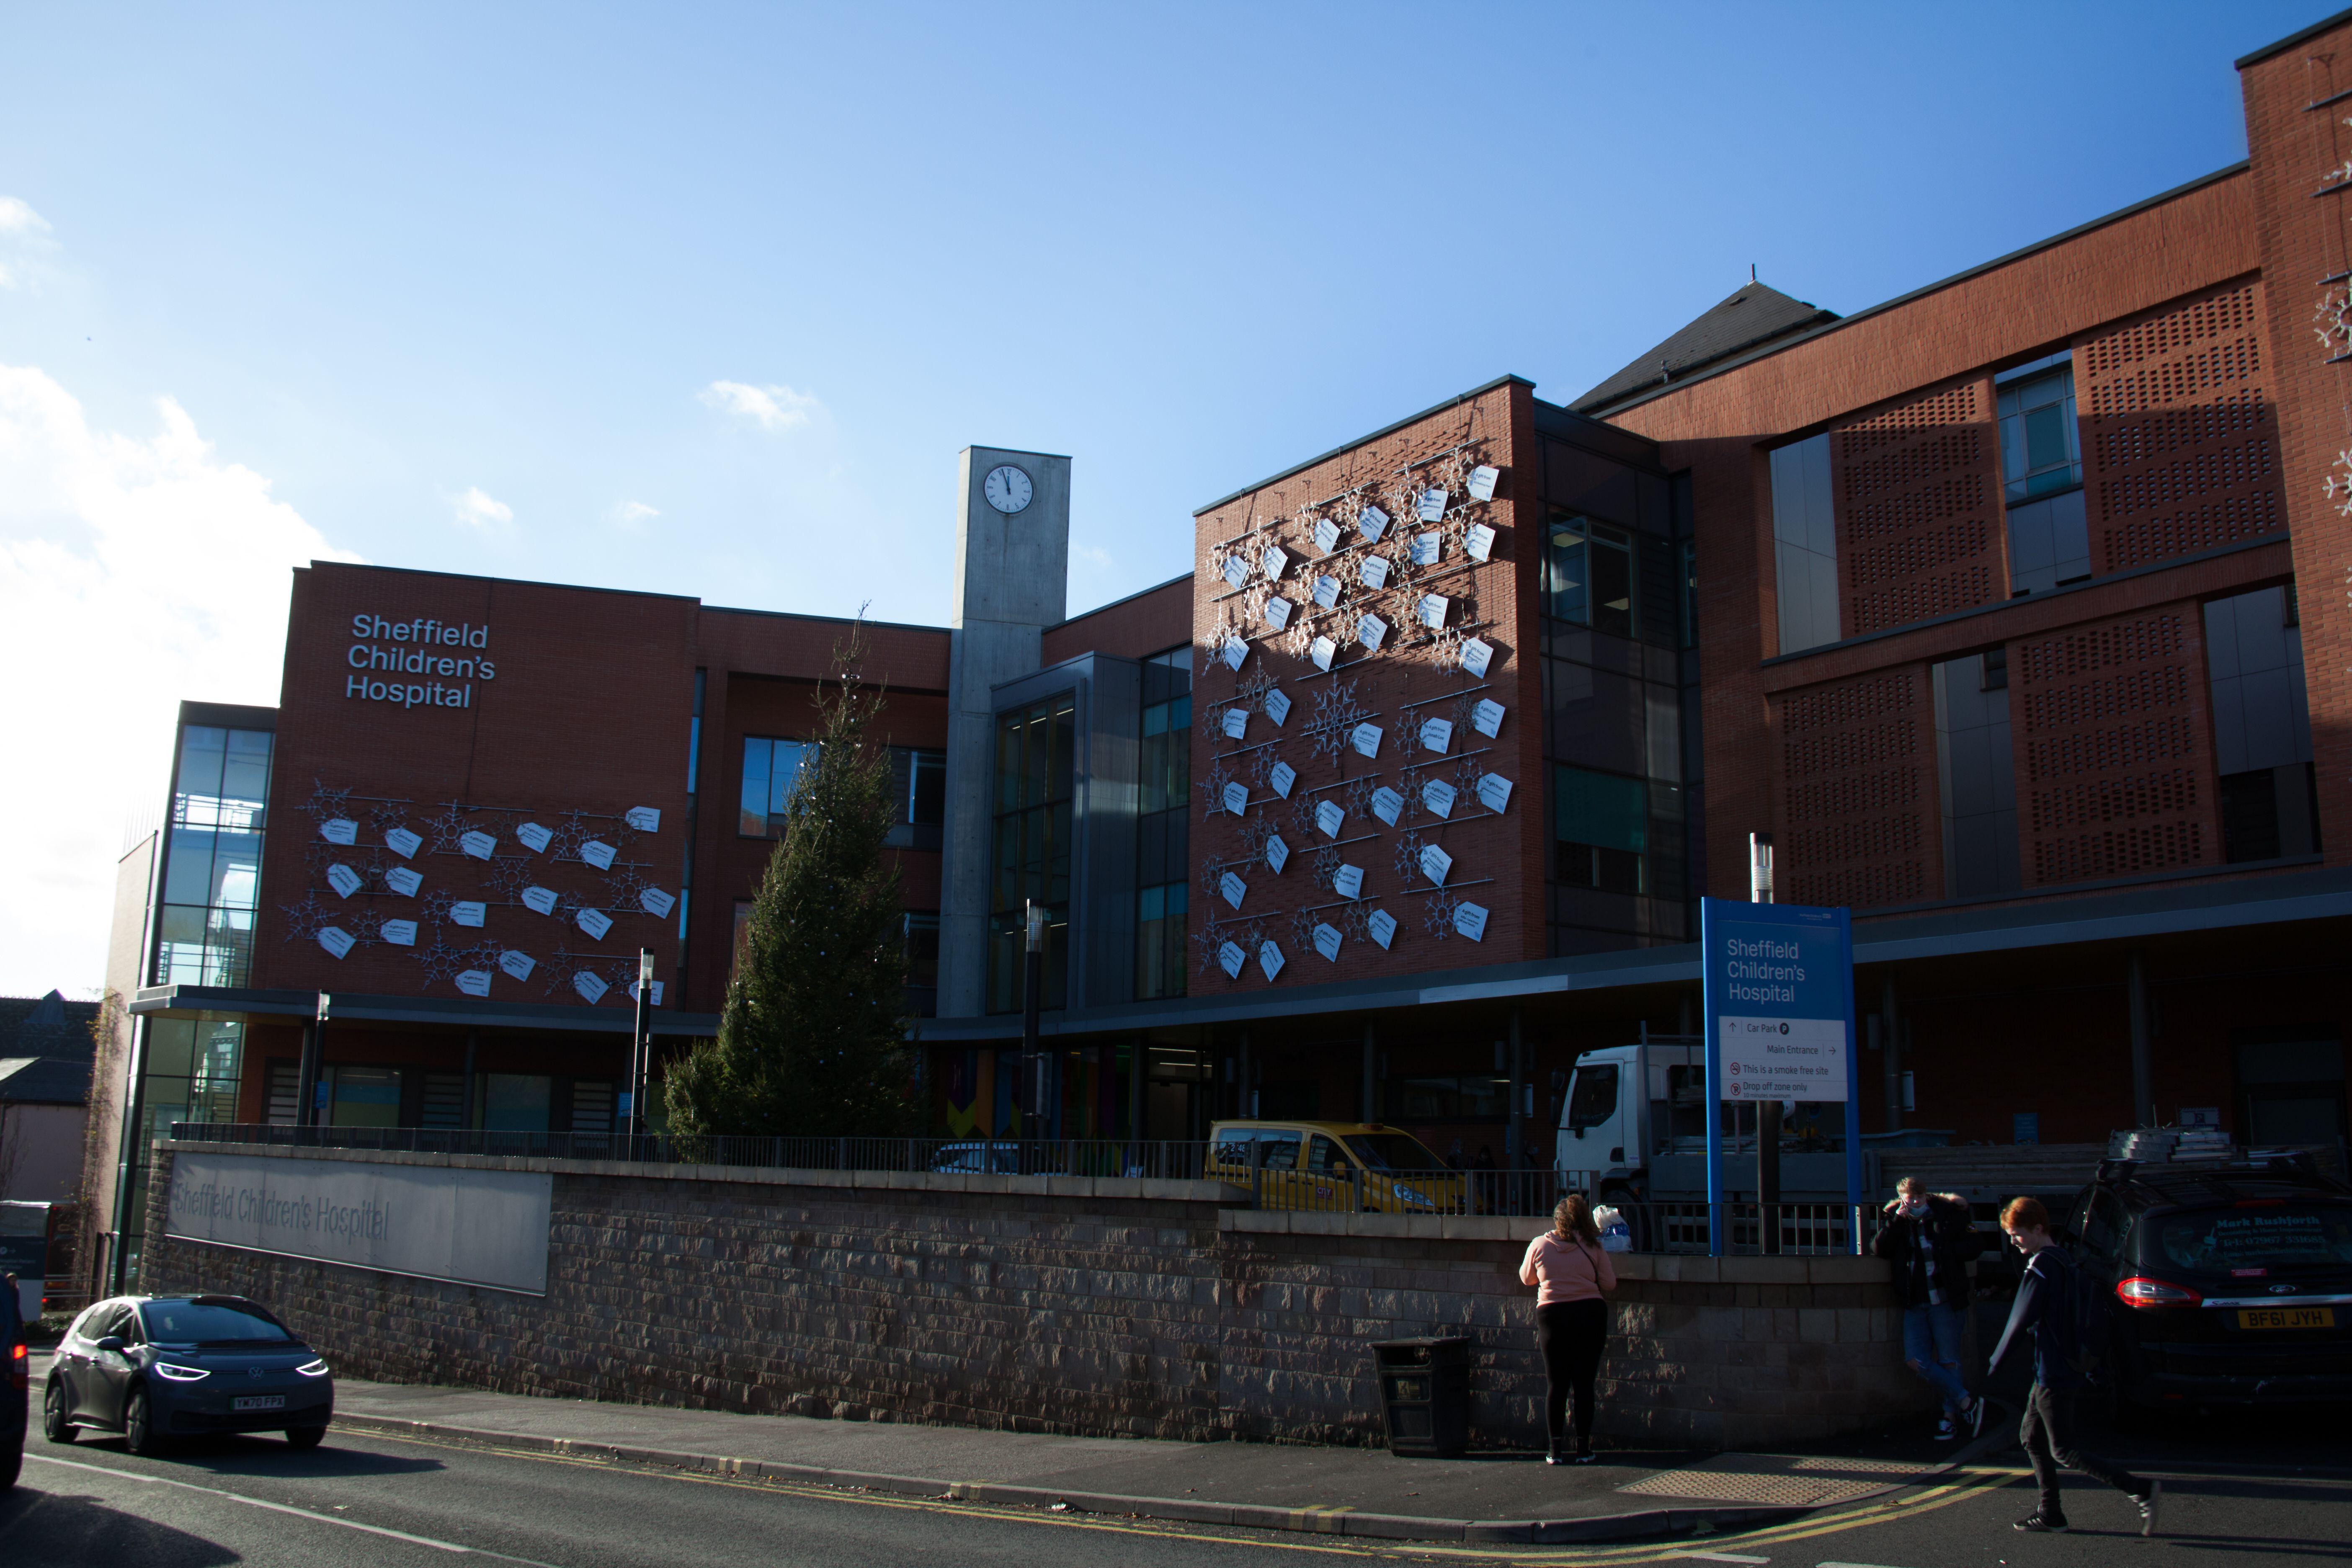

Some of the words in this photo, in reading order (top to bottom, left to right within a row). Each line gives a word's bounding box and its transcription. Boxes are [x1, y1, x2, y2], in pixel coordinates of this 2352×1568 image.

[352, 614, 488, 649] Sheffield
[348, 645, 495, 680] Children’s
[346, 675, 471, 709] Hospital
[1728, 939, 1800, 959] Sheffield
[1728, 961, 1805, 982] Children’s
[1729, 983, 1795, 1005] Hospital
[1747, 1024, 1759, 1032] Car
[1761, 1024, 1777, 1033] Park
[1767, 1045, 1785, 1054] Main
[1787, 1046, 1818, 1055] Entrance
[1743, 1065, 1758, 1073] This
[1774, 1066, 1798, 1075] smoke
[1800, 1066, 1814, 1075] free
[1816, 1067, 1828, 1075] site
[1743, 1082, 1760, 1091] Drop
[1792, 1083, 1807, 1092] only
[1317, 1186, 1331, 1196] CITY
[174, 1182, 235, 1220] Sheffield
[316, 1197, 389, 1245] Hospital
[2215, 1217, 2251, 1228] Mark
[2253, 1215, 2320, 1226] Rushforth
[2223, 1238, 2243, 1247] Tel:
[2245, 1236, 2280, 1245] 07967
[2247, 1312, 2285, 1326] BF61
[2291, 1310, 2324, 1326] JYH
